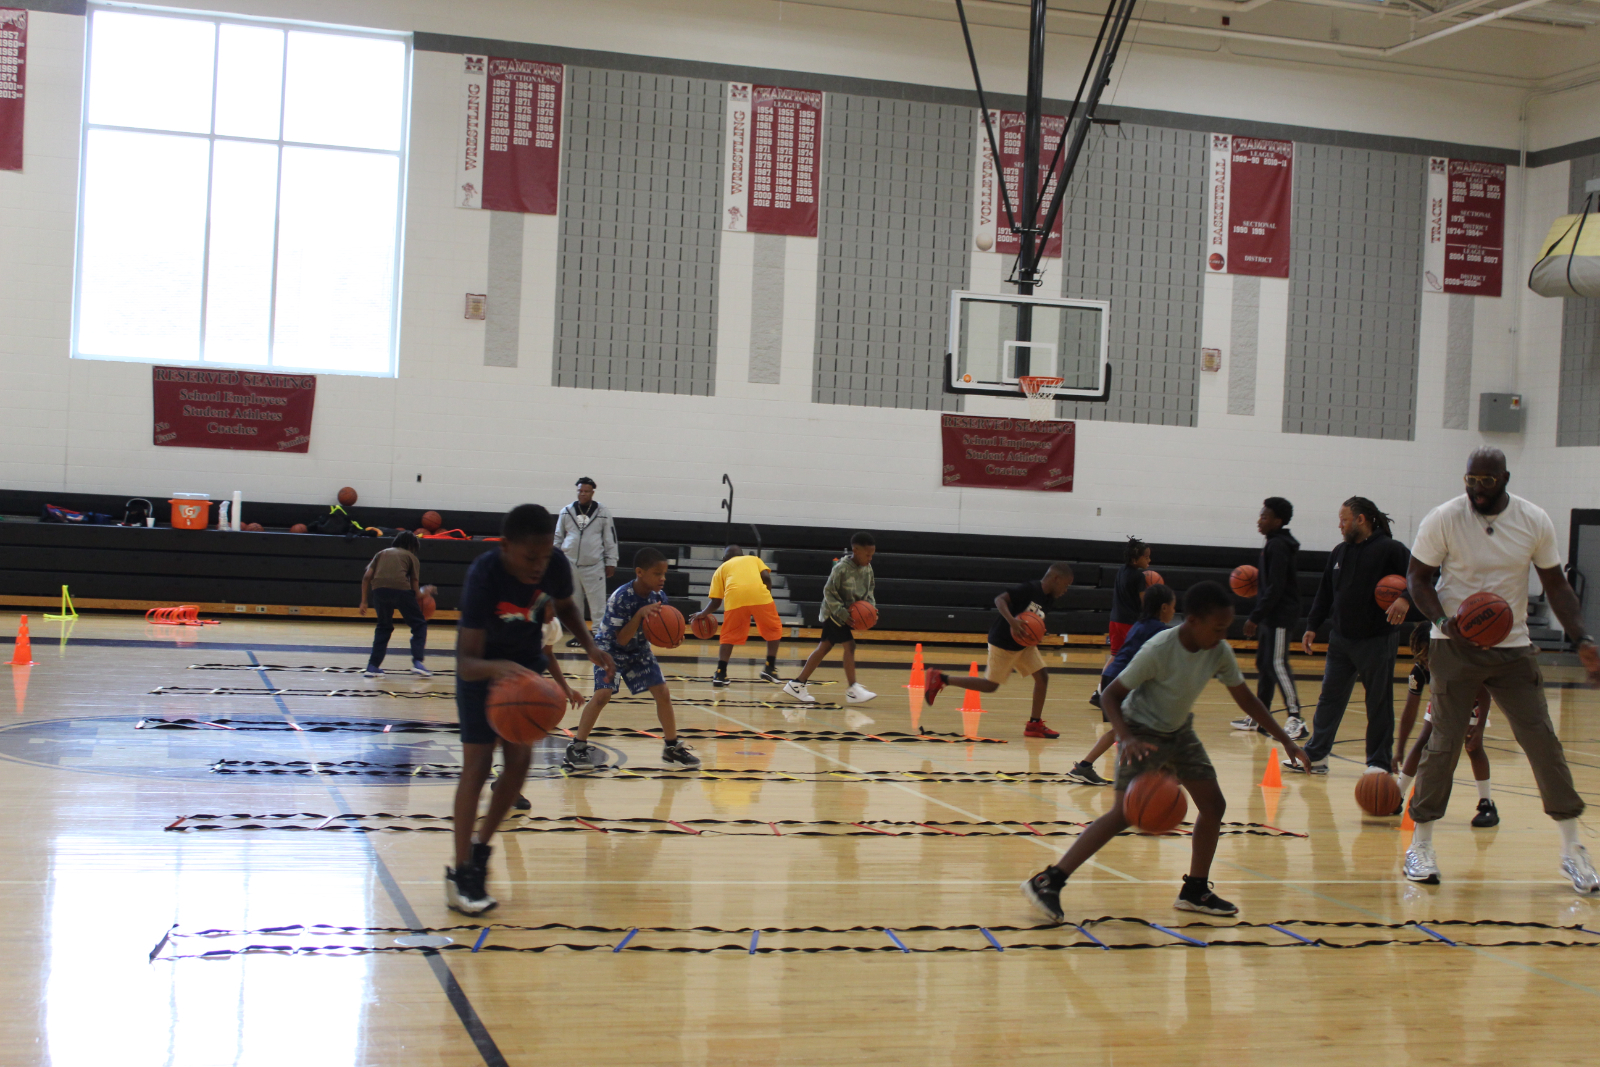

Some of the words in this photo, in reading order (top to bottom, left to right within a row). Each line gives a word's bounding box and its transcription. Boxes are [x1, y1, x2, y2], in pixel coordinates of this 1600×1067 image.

[489, 60, 562, 83] CHAMPIONS
[505, 74, 546, 83] SECTIONAL
[493, 79, 510, 88] 1963
[516, 82, 533, 90] 1964
[538, 84, 555, 92] 1965
[493, 87, 510, 96] 1967
[538, 92, 554, 100] 1969
[753, 86, 821, 109] CHAMPIONS
[492, 103, 509, 111] 1974
[537, 108, 554, 116] 1976
[774, 101, 801, 109] LEAGUE
[465, 84, 480, 171] WRESTLING
[491, 127, 509, 136] 2000
[536, 132, 554, 140] 2009
[491, 135, 508, 143] 2010
[513, 138, 528, 146] 2011
[535, 140, 552, 148] 2012
[1004, 131, 1021, 139] 2004
[490, 143, 507, 151] 2013
[731, 111, 745, 195] WRESTLING
[1233, 138, 1291, 158] CHAMPIONS
[754, 191, 771, 199] 2000
[775, 193, 791, 201] 2001
[796, 195, 813, 203] 2006
[1213, 159, 1225, 245] BASKETBALL
[753, 199, 770, 207] 2012
[775, 201, 791, 209] 2013
[1243, 221, 1276, 229] SECTIONAL
[1431, 198, 1442, 243] TRACK
[155, 369, 239, 385] RESERVED
[243, 375, 312, 389] SEATING
[179, 389, 220, 402] School
[223, 392, 287, 406] Employees
[183, 405, 230, 418] Student
[231, 407, 282, 421] Athletes
[155, 422, 170, 432] No
[207, 422, 258, 435] Coaches
[284, 427, 300, 436] No
[943, 416, 1013, 431] RESERVED
[1015, 420, 1073, 434] SEATING
[155, 432, 176, 443] Fans
[963, 434, 996, 446] School
[999, 436, 1052, 450] Employees
[966, 449, 1004, 461] Student
[1006, 451, 1048, 463] Athletes
[985, 464, 1028, 476] Coaches
[1463, 608, 1496, 632] Wilson
